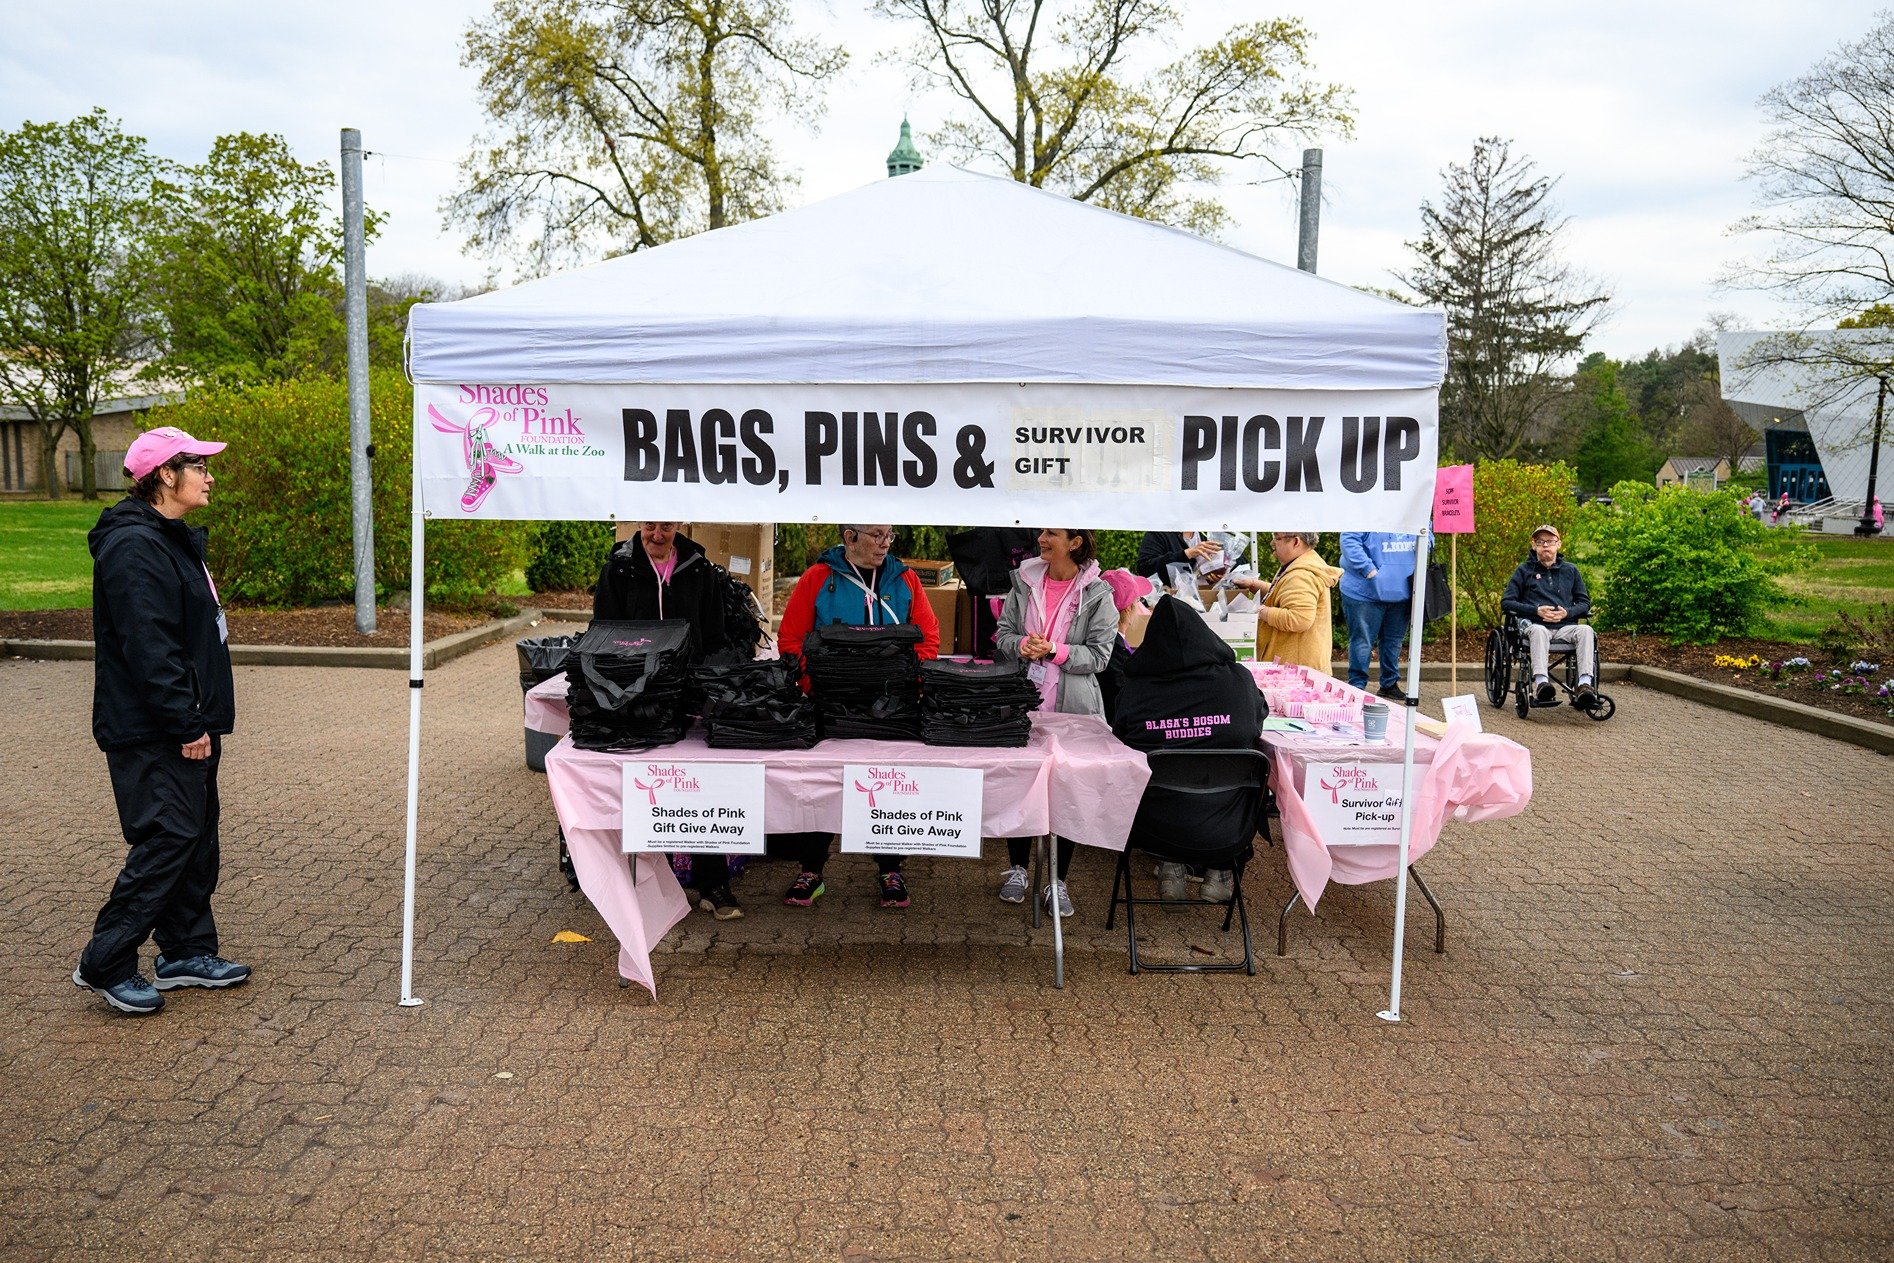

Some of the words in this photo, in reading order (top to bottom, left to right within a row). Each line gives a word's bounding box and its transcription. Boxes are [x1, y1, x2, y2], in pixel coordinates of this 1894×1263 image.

[459, 383, 549, 406] Shades
[503, 408, 519, 422] of
[521, 407, 586, 436] Pink
[520, 435, 586, 444] FOUNDATION
[1014, 426, 1146, 445] SURVIVOR
[503, 443, 514, 454] A
[516, 443, 546, 456] Walk
[548, 445, 559, 456] at
[562, 444, 580, 457] the
[582, 445, 606, 457] Zoo
[622, 408, 790, 494] BAGS,
[804, 411, 938, 489] PINS
[953, 424, 995, 489] &
[1181, 415, 1326, 493] PICK
[1339, 416, 1421, 493] UP
[1014, 457, 1071, 475] GIFT
[1145, 717, 1190, 730] BLASA'S
[1192, 714, 1231, 727] BOSOM
[1165, 727, 1212, 739] BUDDIES
[647, 764, 687, 777] Shades
[867, 767, 906, 780] Shades
[1332, 766, 1367, 778] Shades
[673, 776, 700, 789] Pink
[892, 780, 920, 792] Pink
[1354, 778, 1378, 789] Pink
[1341, 799, 1383, 808] Survivor
[651, 807, 698, 818] Shades
[702, 808, 714, 819] of
[718, 808, 746, 819] Pink
[870, 809, 917, 821] Shades
[920, 811, 933, 821] of
[936, 811, 963, 823] Pink
[1355, 812, 1395, 823] Pick-up
[653, 823, 676, 833] Gift
[679, 823, 707, 834] Give
[710, 824, 744, 836] Away
[871, 825, 894, 836] Gift
[897, 825, 924, 836] Give
[927, 826, 962, 839] Away
